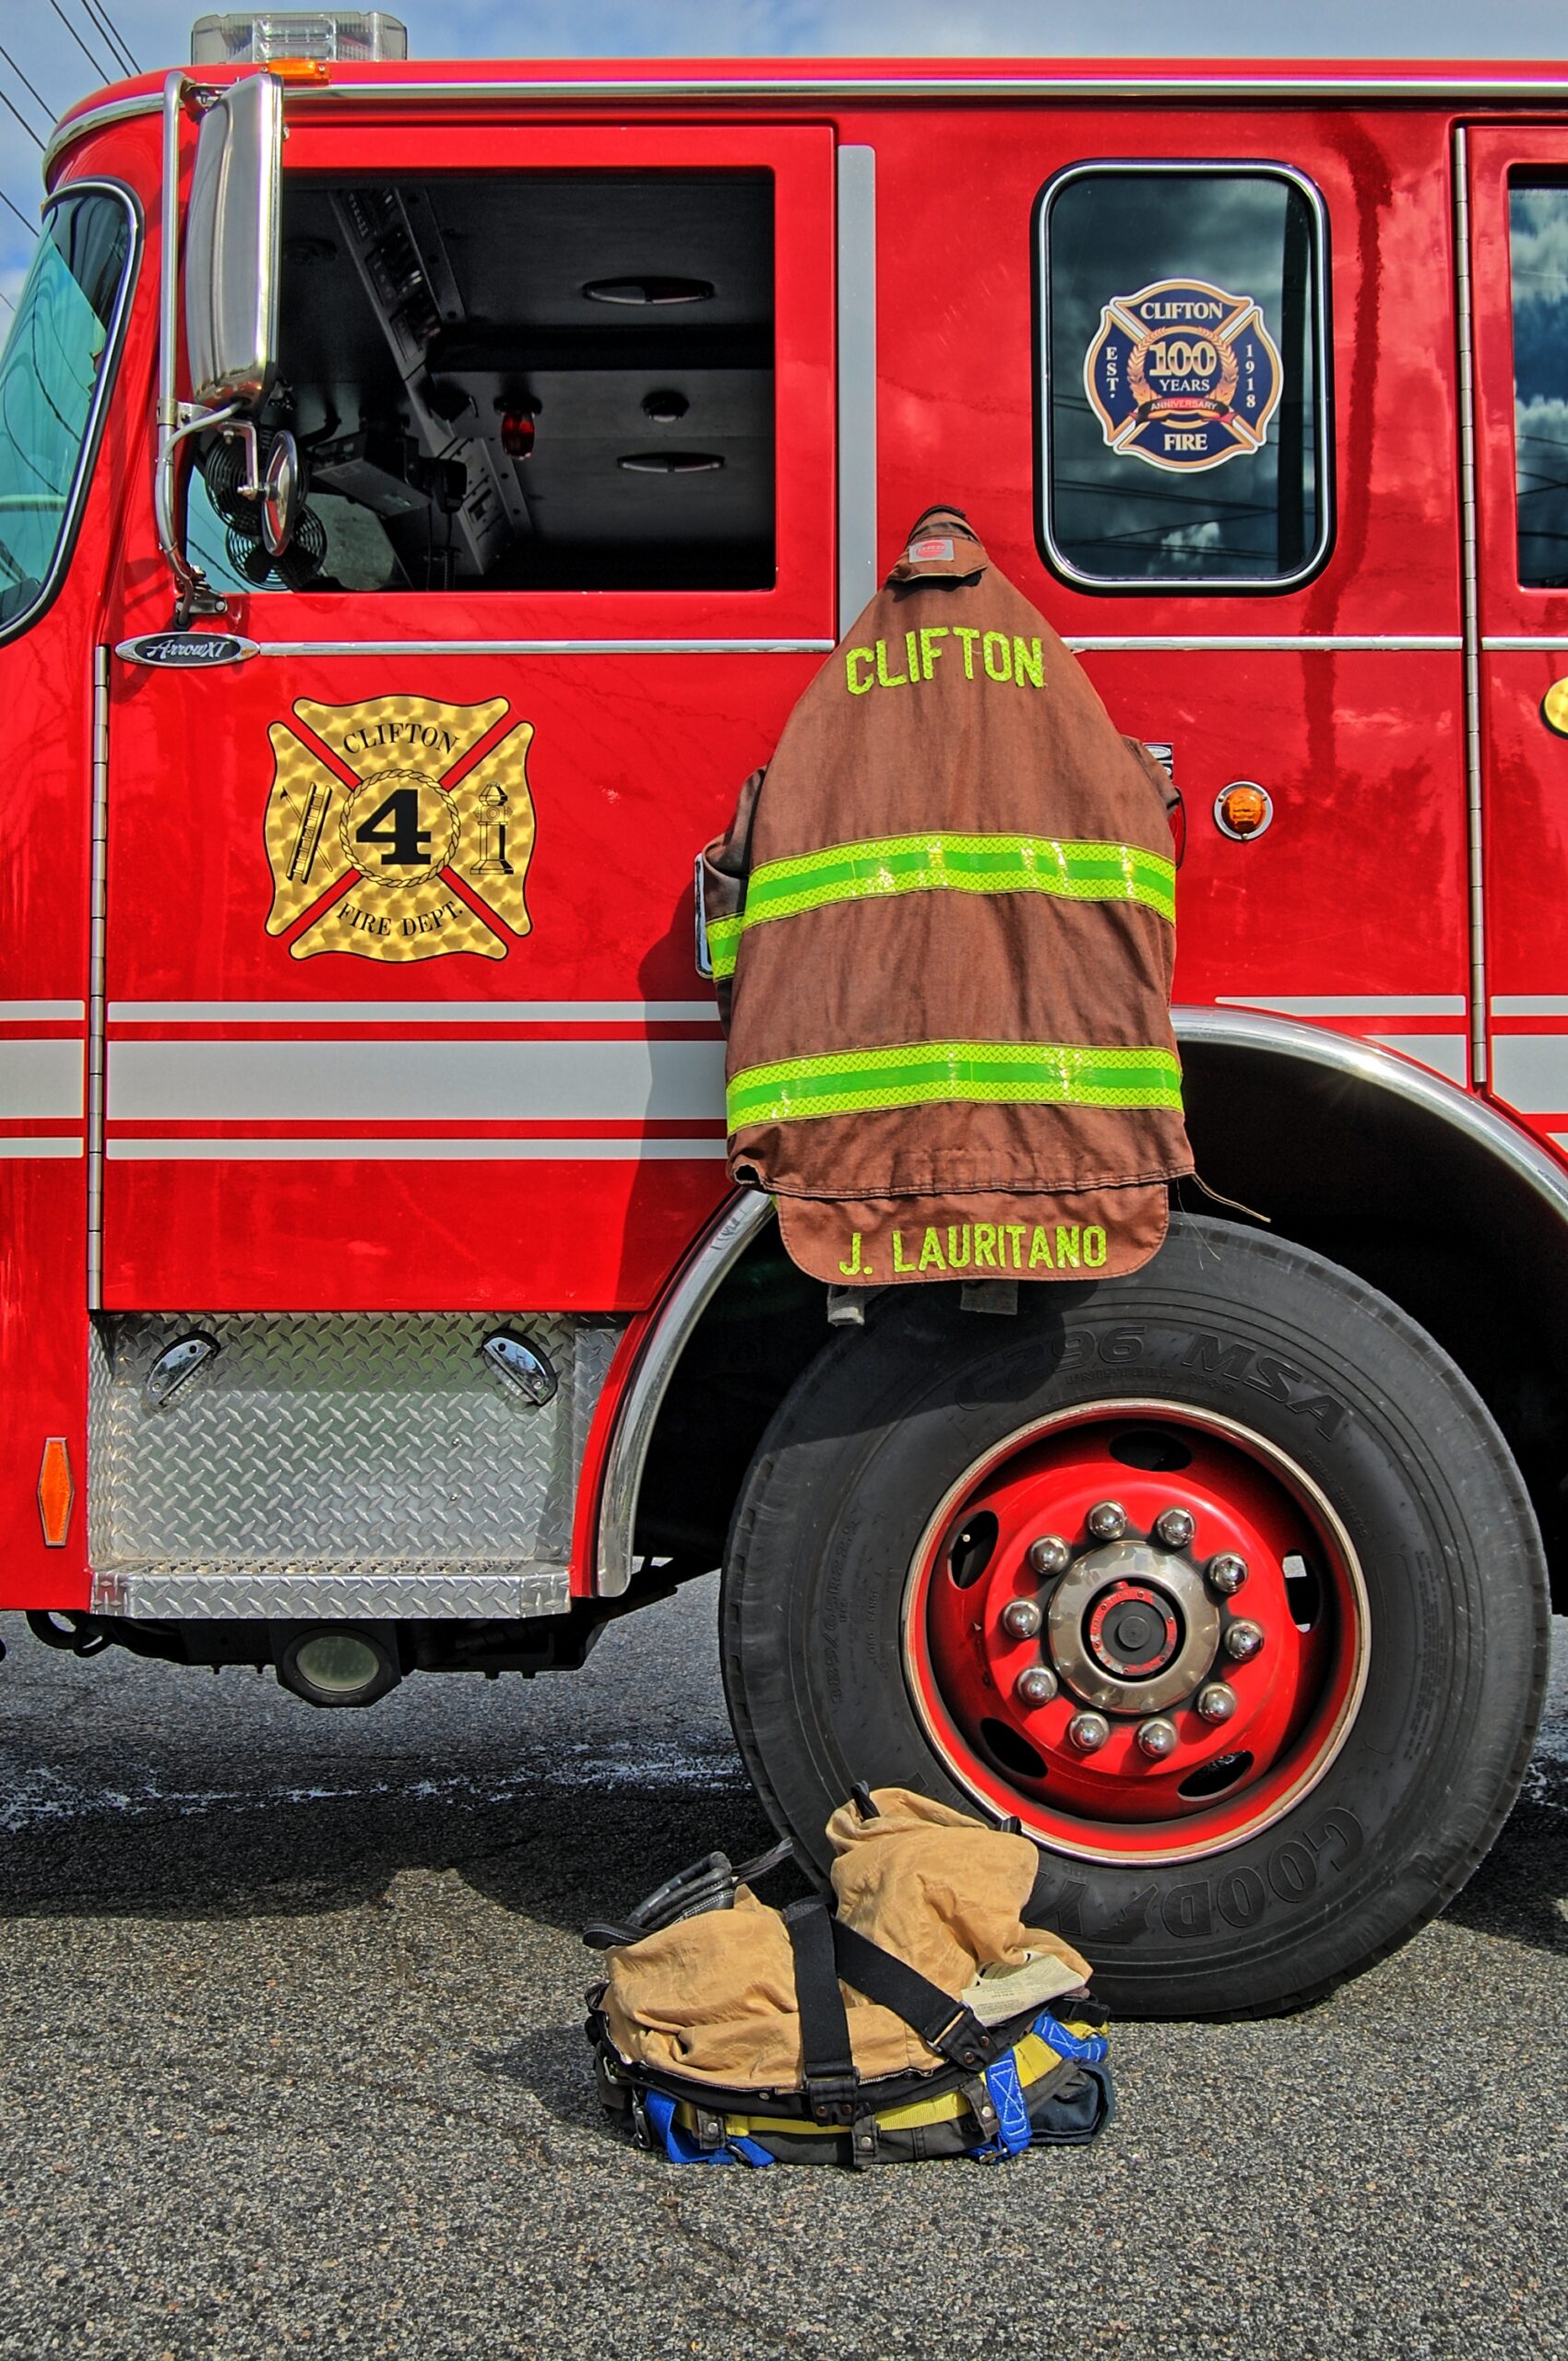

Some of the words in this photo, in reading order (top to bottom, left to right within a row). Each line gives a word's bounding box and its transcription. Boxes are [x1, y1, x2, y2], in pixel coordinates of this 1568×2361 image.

[1140, 302, 1223, 319] CLIFTON
[1148, 341, 1217, 376] 100
[1245, 344, 1256, 408] 1918
[1159, 379, 1210, 392] YEARS
[1150, 399, 1218, 411] ANNIVERSARY
[1164, 433, 1207, 451] FIRE
[846, 626, 1045, 695] CLIFTON
[343, 721, 460, 754] CLIFTON
[355, 789, 432, 865] 4
[337, 902, 391, 936] FIRE
[401, 900, 463, 937] DEPT.
[838, 1232, 873, 1275] J.
[892, 1222, 1107, 1274] LAURITANO
[1182, 1332, 1351, 1442] MSA
